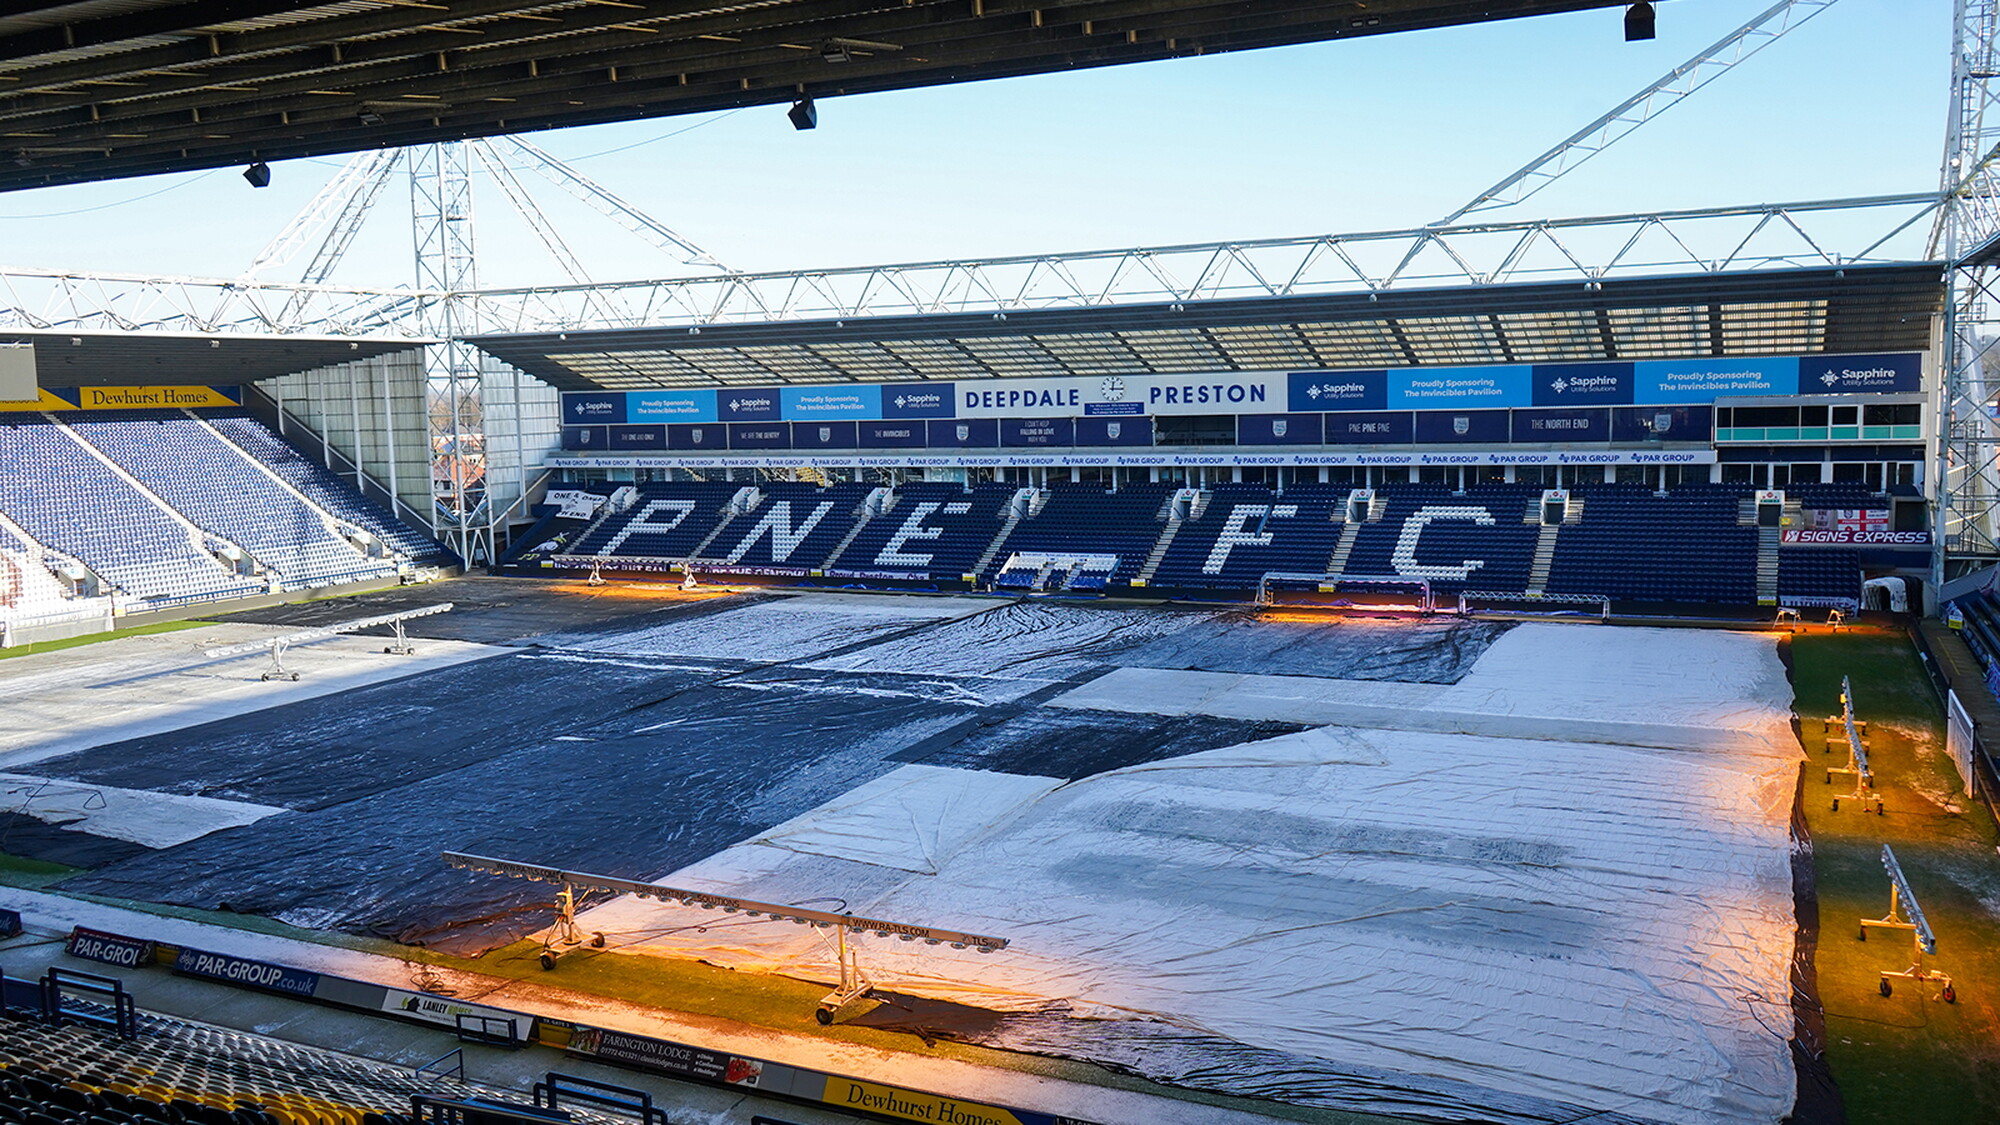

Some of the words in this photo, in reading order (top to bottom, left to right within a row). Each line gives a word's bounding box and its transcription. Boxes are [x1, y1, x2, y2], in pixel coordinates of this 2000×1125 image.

[1667, 372, 1704, 382] Proudly
[1706, 370, 1762, 380] Sponsoring
[1842, 368, 1896, 381] Sapphire
[1412, 380, 1444, 388] Proudly
[1446, 379, 1494, 388] Sponsoring
[1570, 376, 1617, 387] Sapphire
[1658, 382, 1675, 391] The
[1677, 381, 1729, 390] Invincibles
[1731, 380, 1771, 389] Pavilion
[1323, 383, 1365, 394] Sapphire
[1421, 389, 1466, 397] Invincibles
[1468, 388, 1502, 396] Pavilion
[92, 389, 158, 405] Dewhurst
[163, 389, 208, 404] Homes
[907, 394, 940, 403] Sapphire
[966, 389, 1079, 408] DEEPDALE
[1150, 384, 1266, 404] PRESTON
[740, 398, 770, 407] Sapphire
[1349, 423, 1361, 433] PNE
[1362, 423, 1376, 432] PNE
[1377, 422, 1390, 432] PNE
[1531, 419, 1544, 429] THE
[1545, 419, 1571, 429] NORTH
[1573, 418, 1589, 429] END
[1643, 454, 1660, 462] PAR
[1662, 454, 1695, 462] GROUP
[1800, 530, 1849, 543] SIGNS
[1853, 531, 1928, 544] EXPRESS
[696, 894, 740, 908] SOLUTIONS
[852, 919, 930, 938] WWW.RA-TLS.COM
[971, 937, 988, 947] TLS
[195, 954, 314, 994] PAR-GROUP.co.uk
[422, 1000, 448, 1014] LANLEY
[600, 1047, 617, 1057] 01772
[602, 1034, 658, 1054] FARINGTON
[658, 1044, 692, 1061] LODGE
[847, 1084, 933, 1119] Dewhurst
[936, 1101, 1002, 1125] Homes
